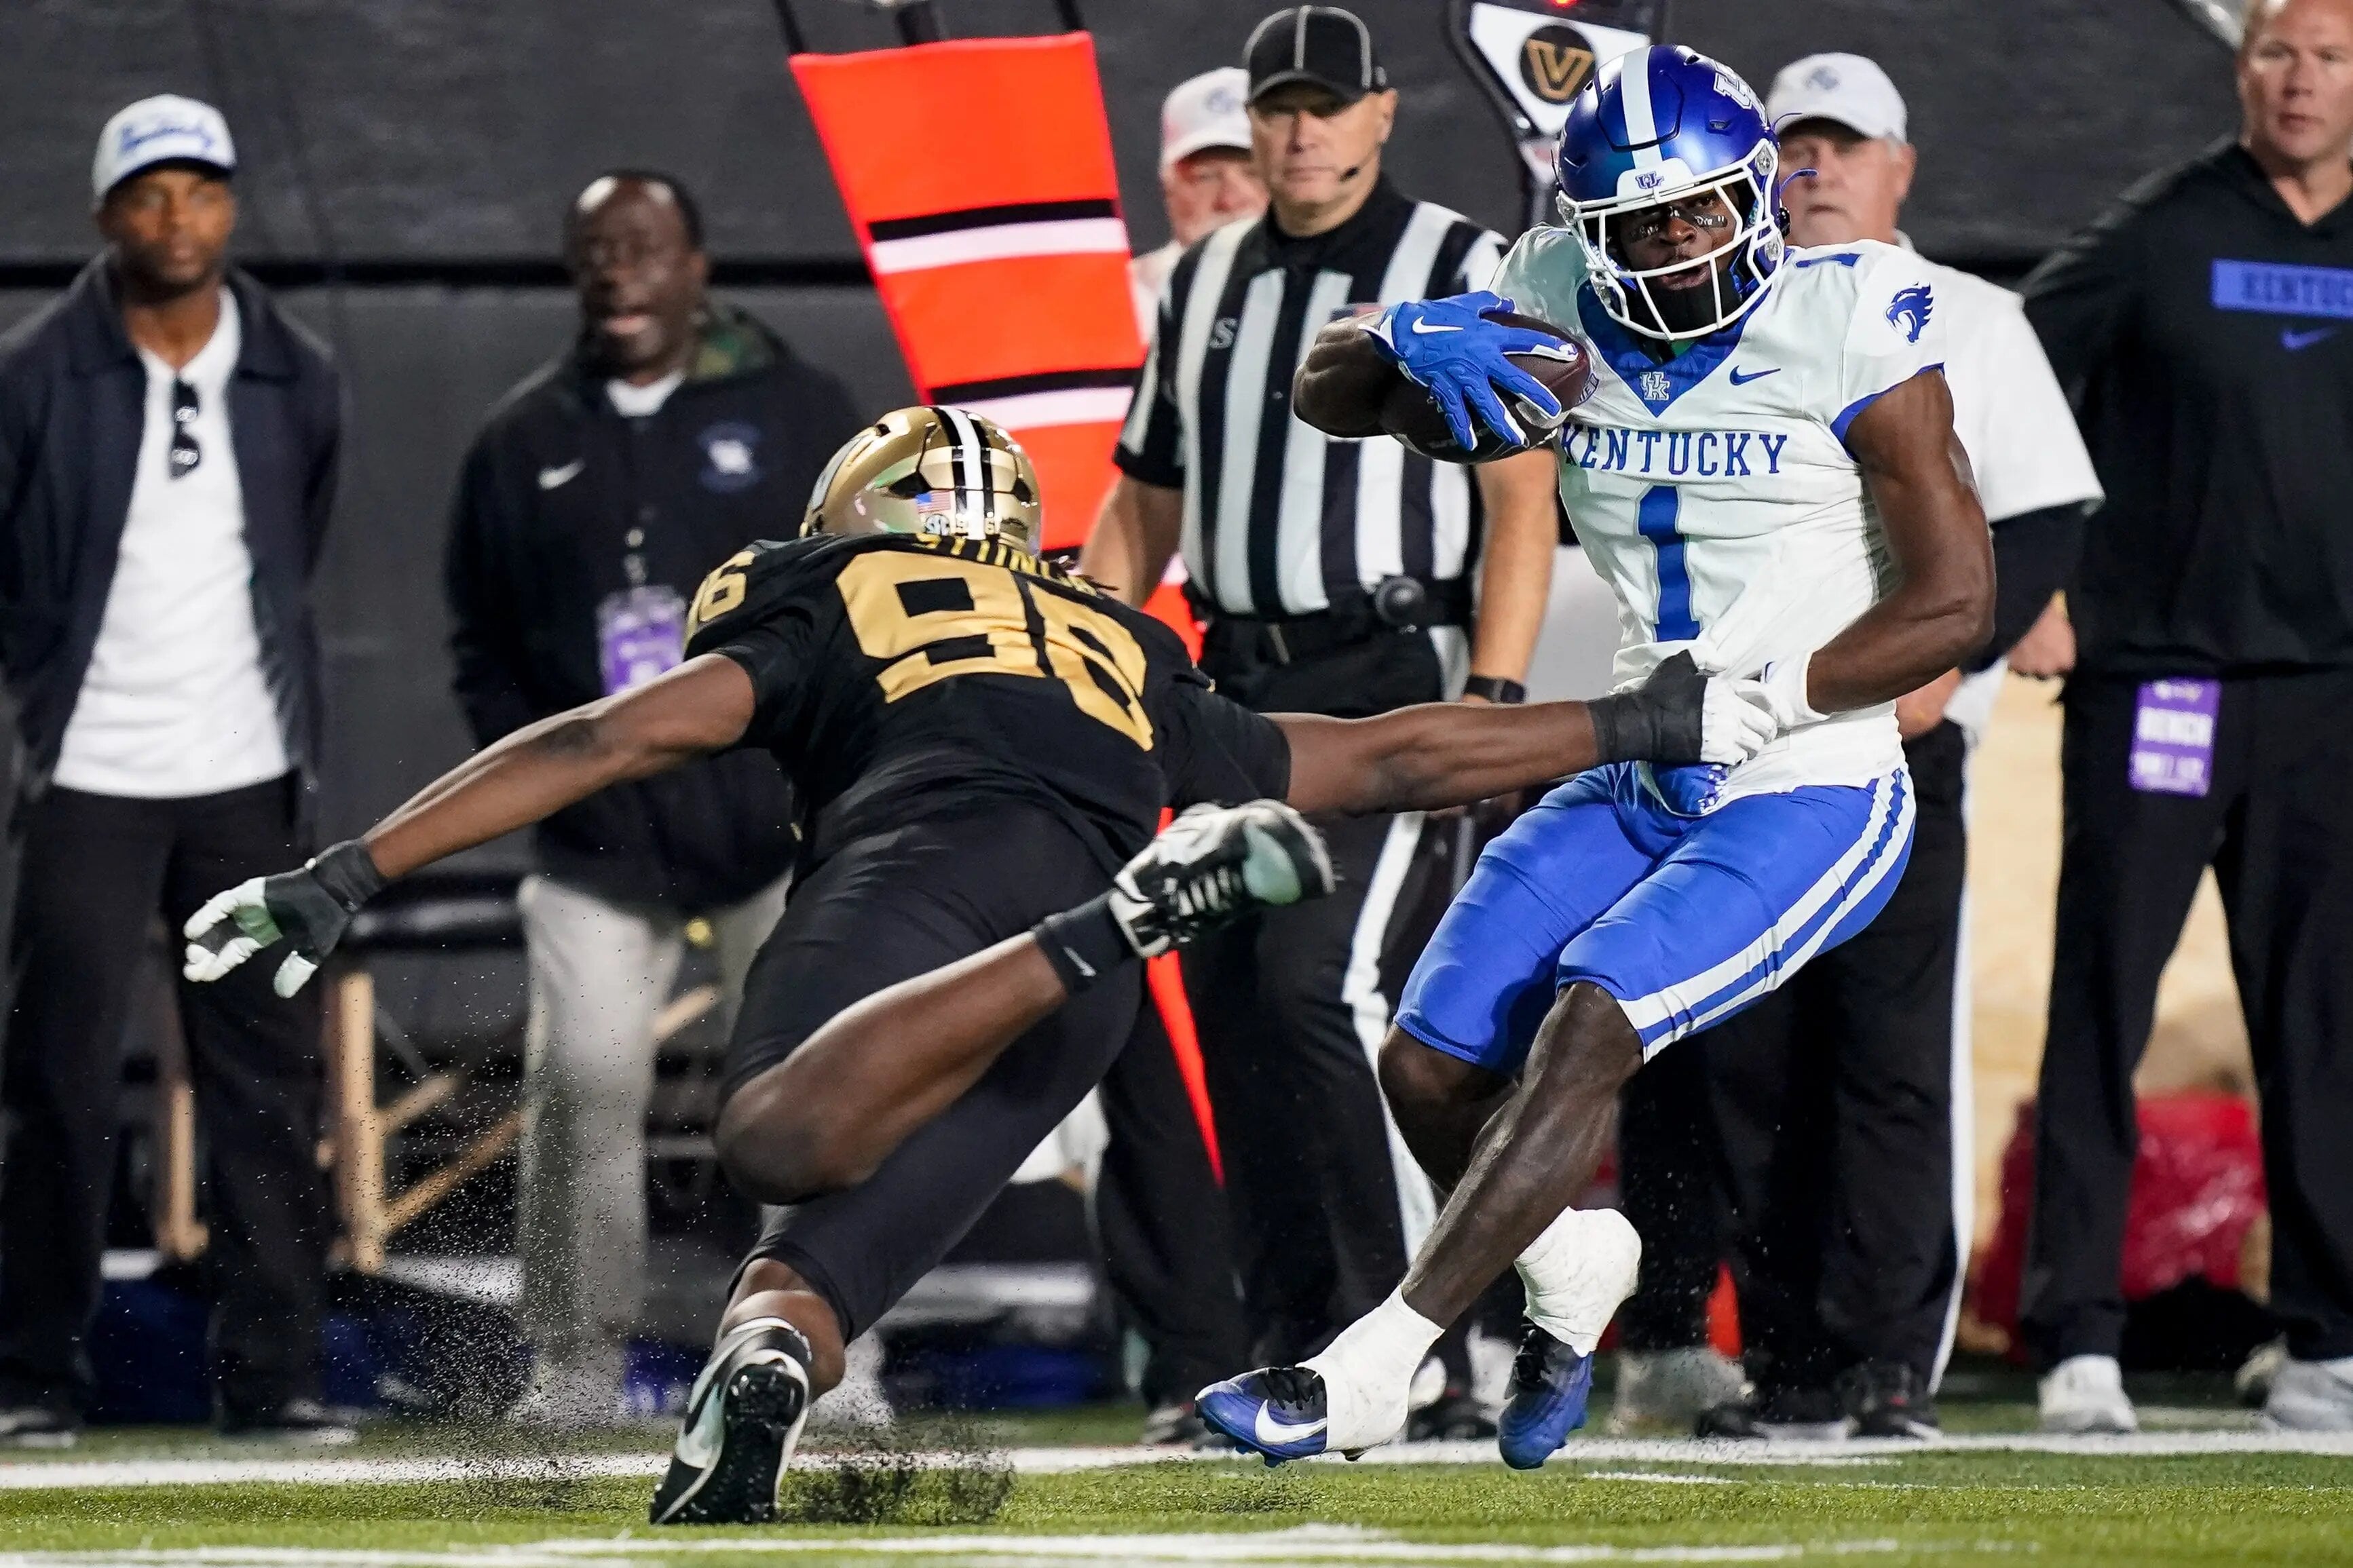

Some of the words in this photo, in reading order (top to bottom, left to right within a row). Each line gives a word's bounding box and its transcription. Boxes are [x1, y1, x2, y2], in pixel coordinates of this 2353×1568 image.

[1526, 39, 1594, 100] V
[1209, 317, 1237, 349] S
[1640, 372, 1670, 401] UK
[1562, 423, 1788, 476] KENTUCKY
[1638, 485, 1700, 642] 1
[835, 550, 1154, 752] 96
